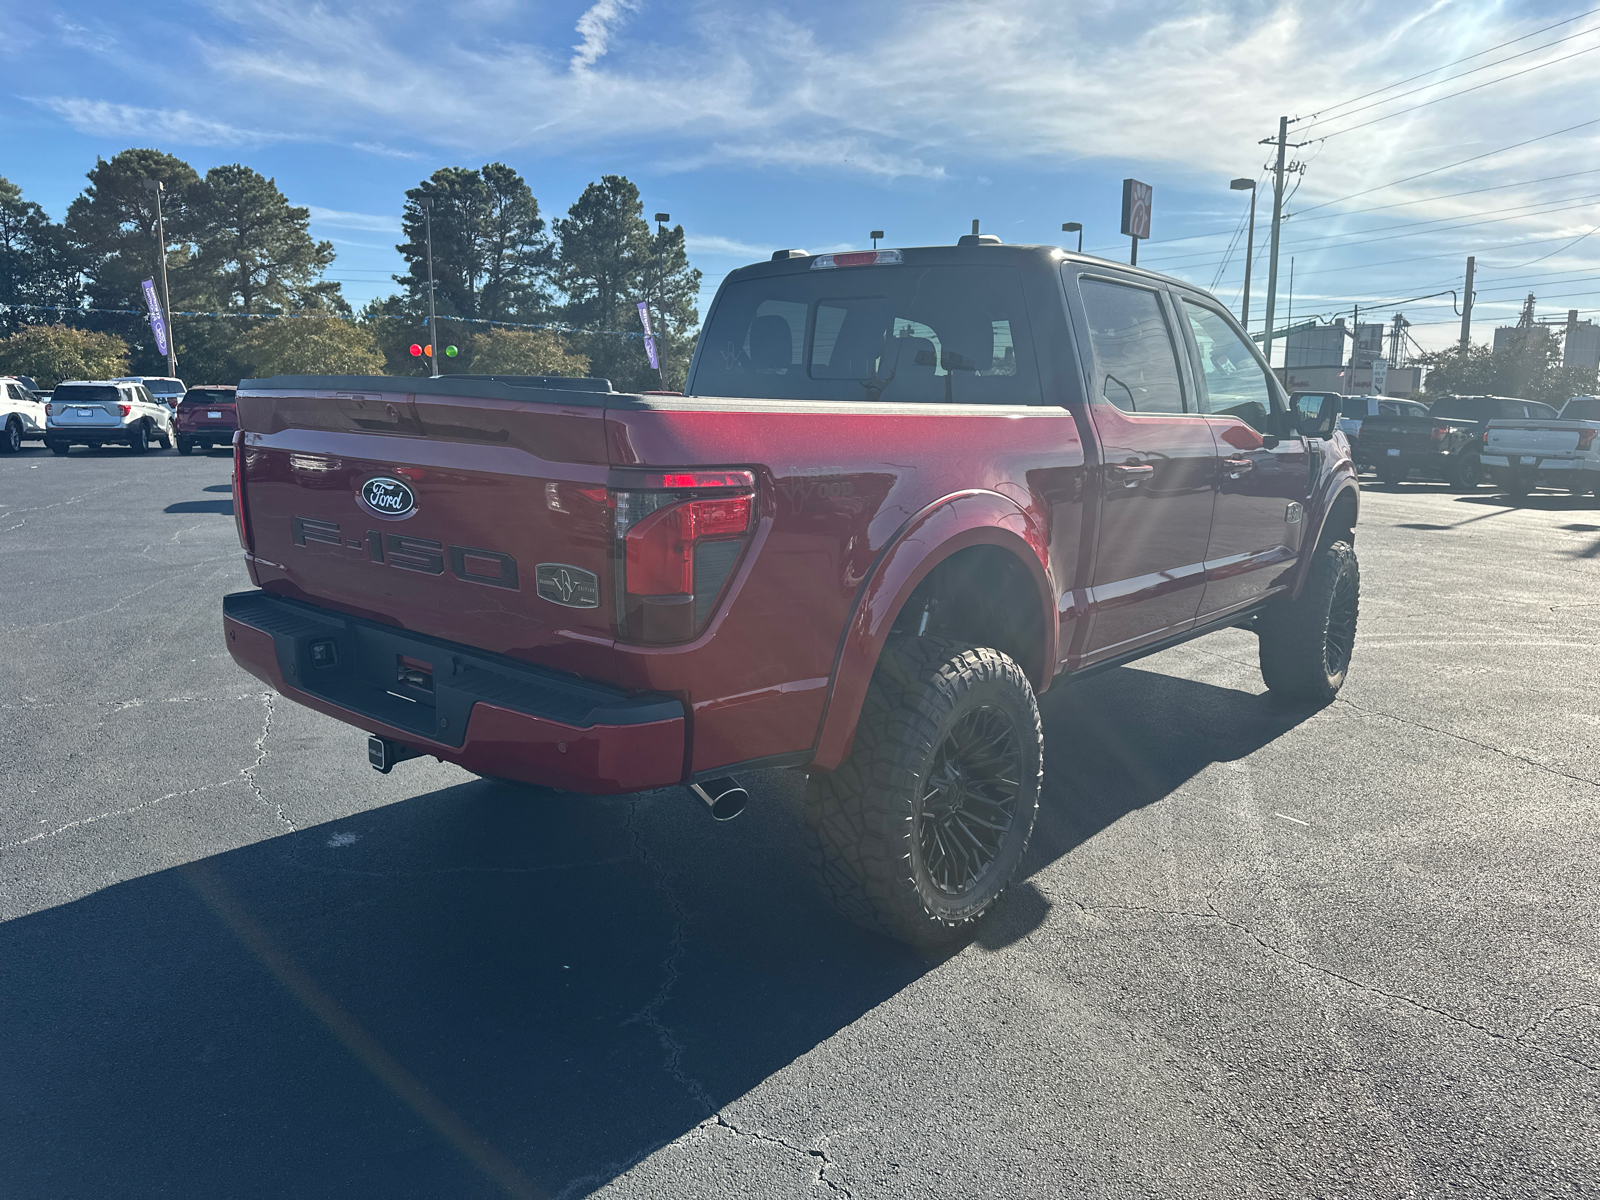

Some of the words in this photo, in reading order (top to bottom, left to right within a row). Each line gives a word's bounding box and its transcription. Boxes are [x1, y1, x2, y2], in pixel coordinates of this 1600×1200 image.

[1374, 362, 1386, 370] STOP
[370, 482, 403, 509] Ford
[292, 515, 520, 592] F-150
